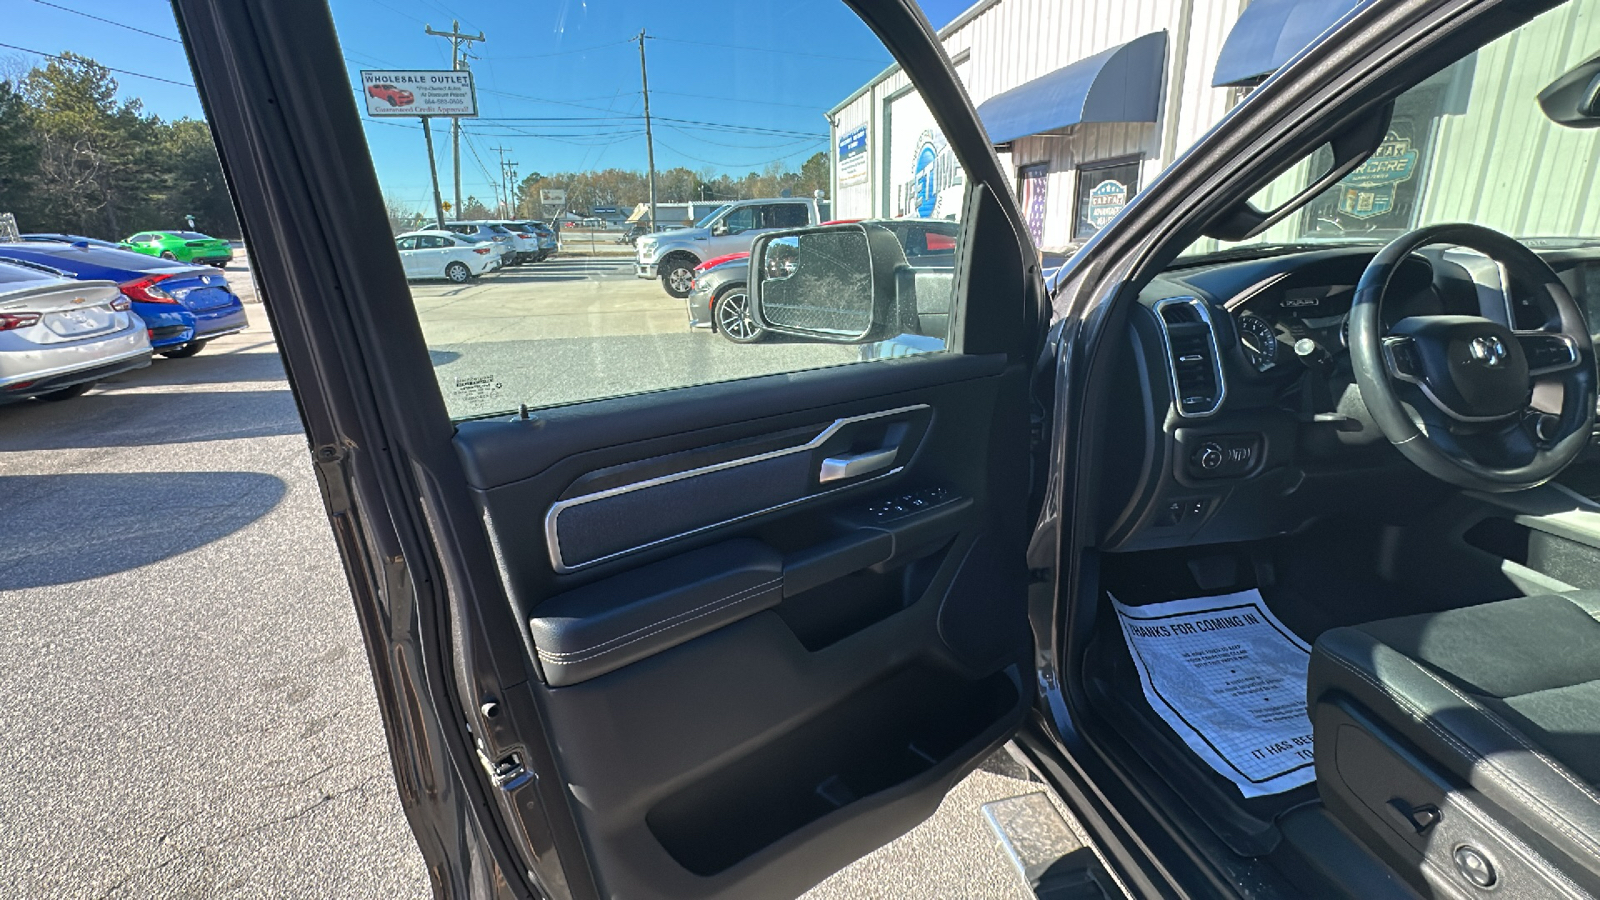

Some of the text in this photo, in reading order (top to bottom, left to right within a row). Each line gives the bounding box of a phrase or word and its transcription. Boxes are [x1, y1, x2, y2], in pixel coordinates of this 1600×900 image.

[430, 76, 468, 84] OUTLET
[1130, 613, 1260, 638] THANKS FOR COMING IN
[1251, 749, 1266, 760] IT
[1264, 741, 1294, 756] HAS
